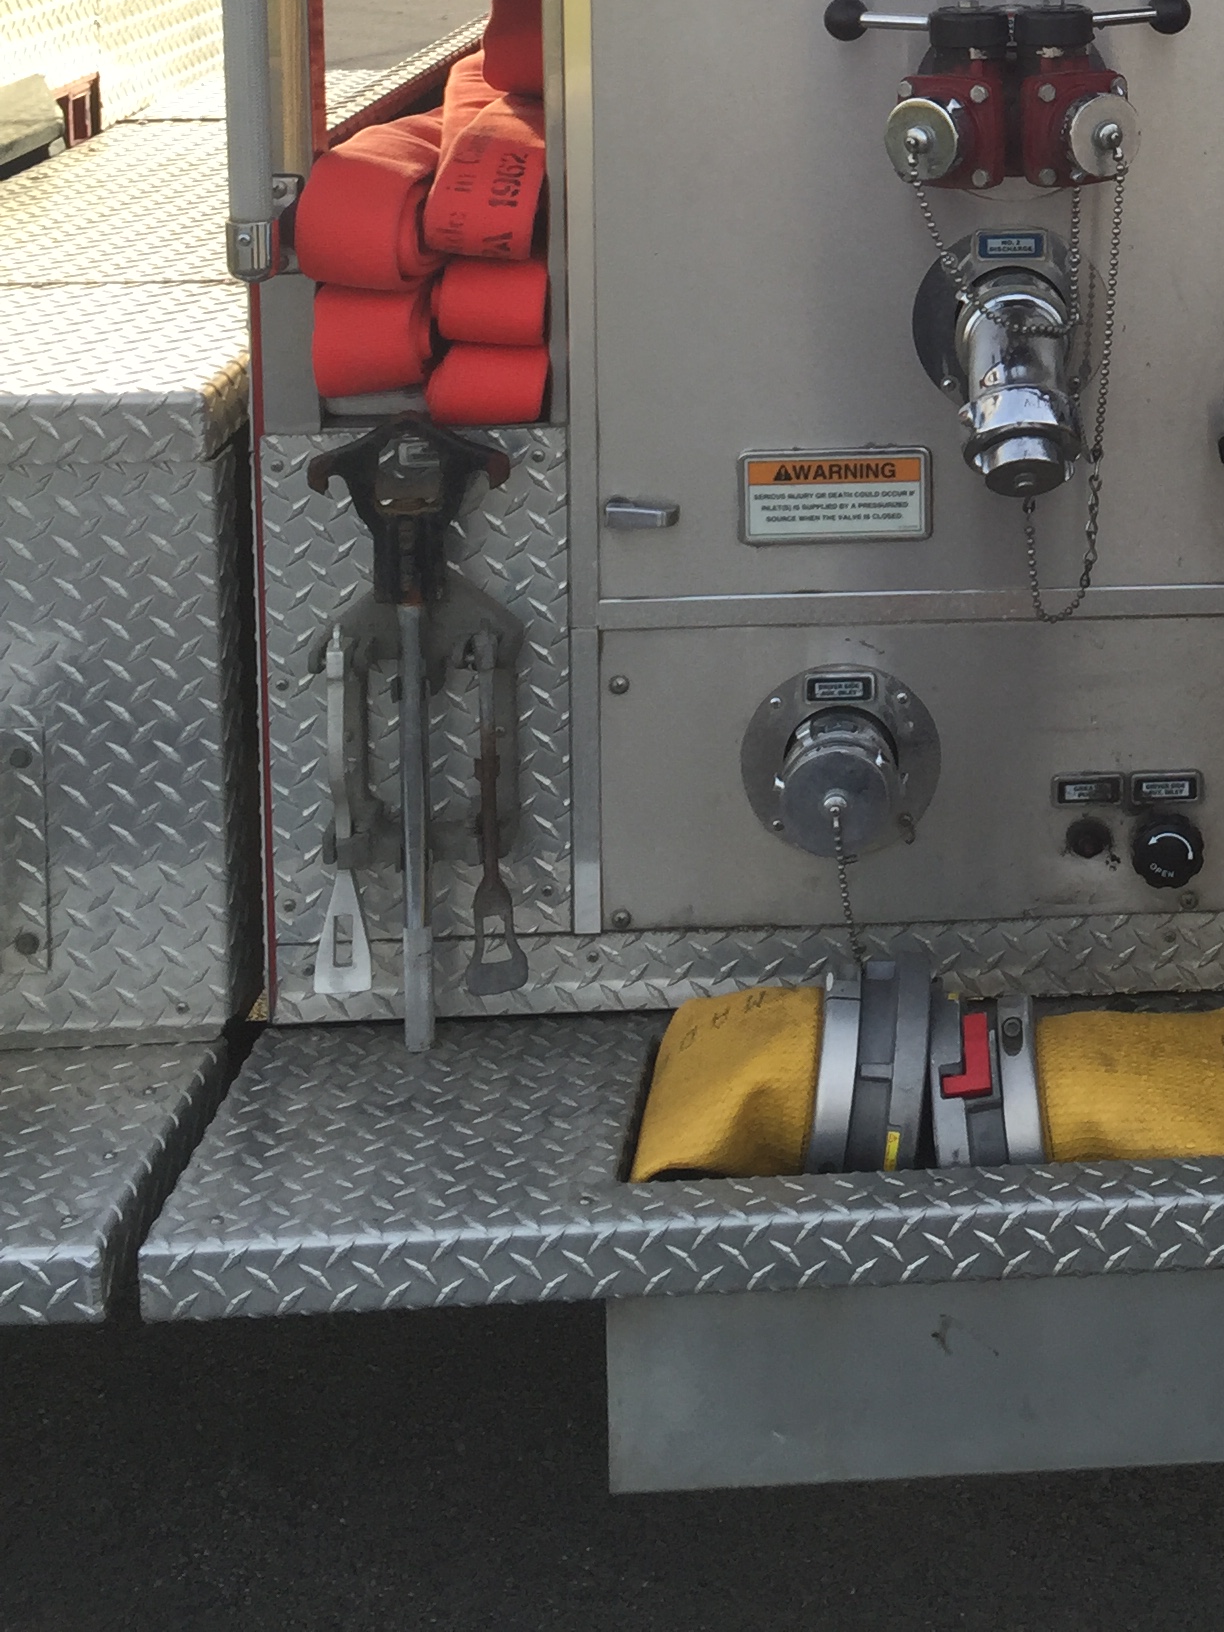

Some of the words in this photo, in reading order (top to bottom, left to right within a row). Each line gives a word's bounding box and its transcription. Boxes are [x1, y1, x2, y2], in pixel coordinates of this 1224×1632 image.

[488, 152, 529, 207] 1962
[792, 462, 896, 481] WARNING
[1149, 862, 1175, 878] OPEN
